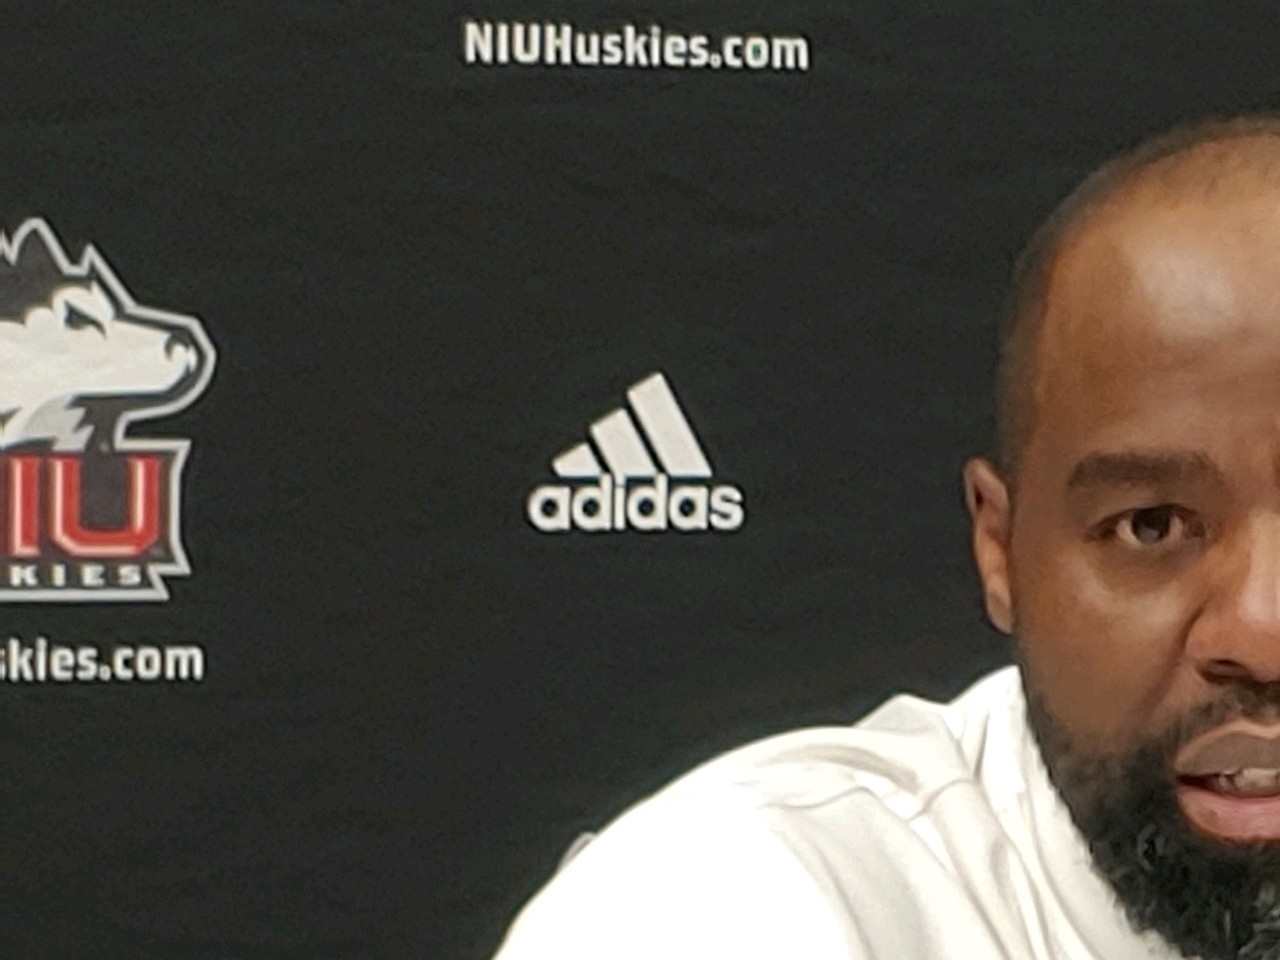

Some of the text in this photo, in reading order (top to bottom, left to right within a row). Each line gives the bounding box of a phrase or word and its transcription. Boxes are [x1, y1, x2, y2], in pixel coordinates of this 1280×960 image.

[464, 21, 810, 71] NIUHuskies.com
[528, 472, 745, 532] adidas
[0, 636, 205, 682] kies.com
